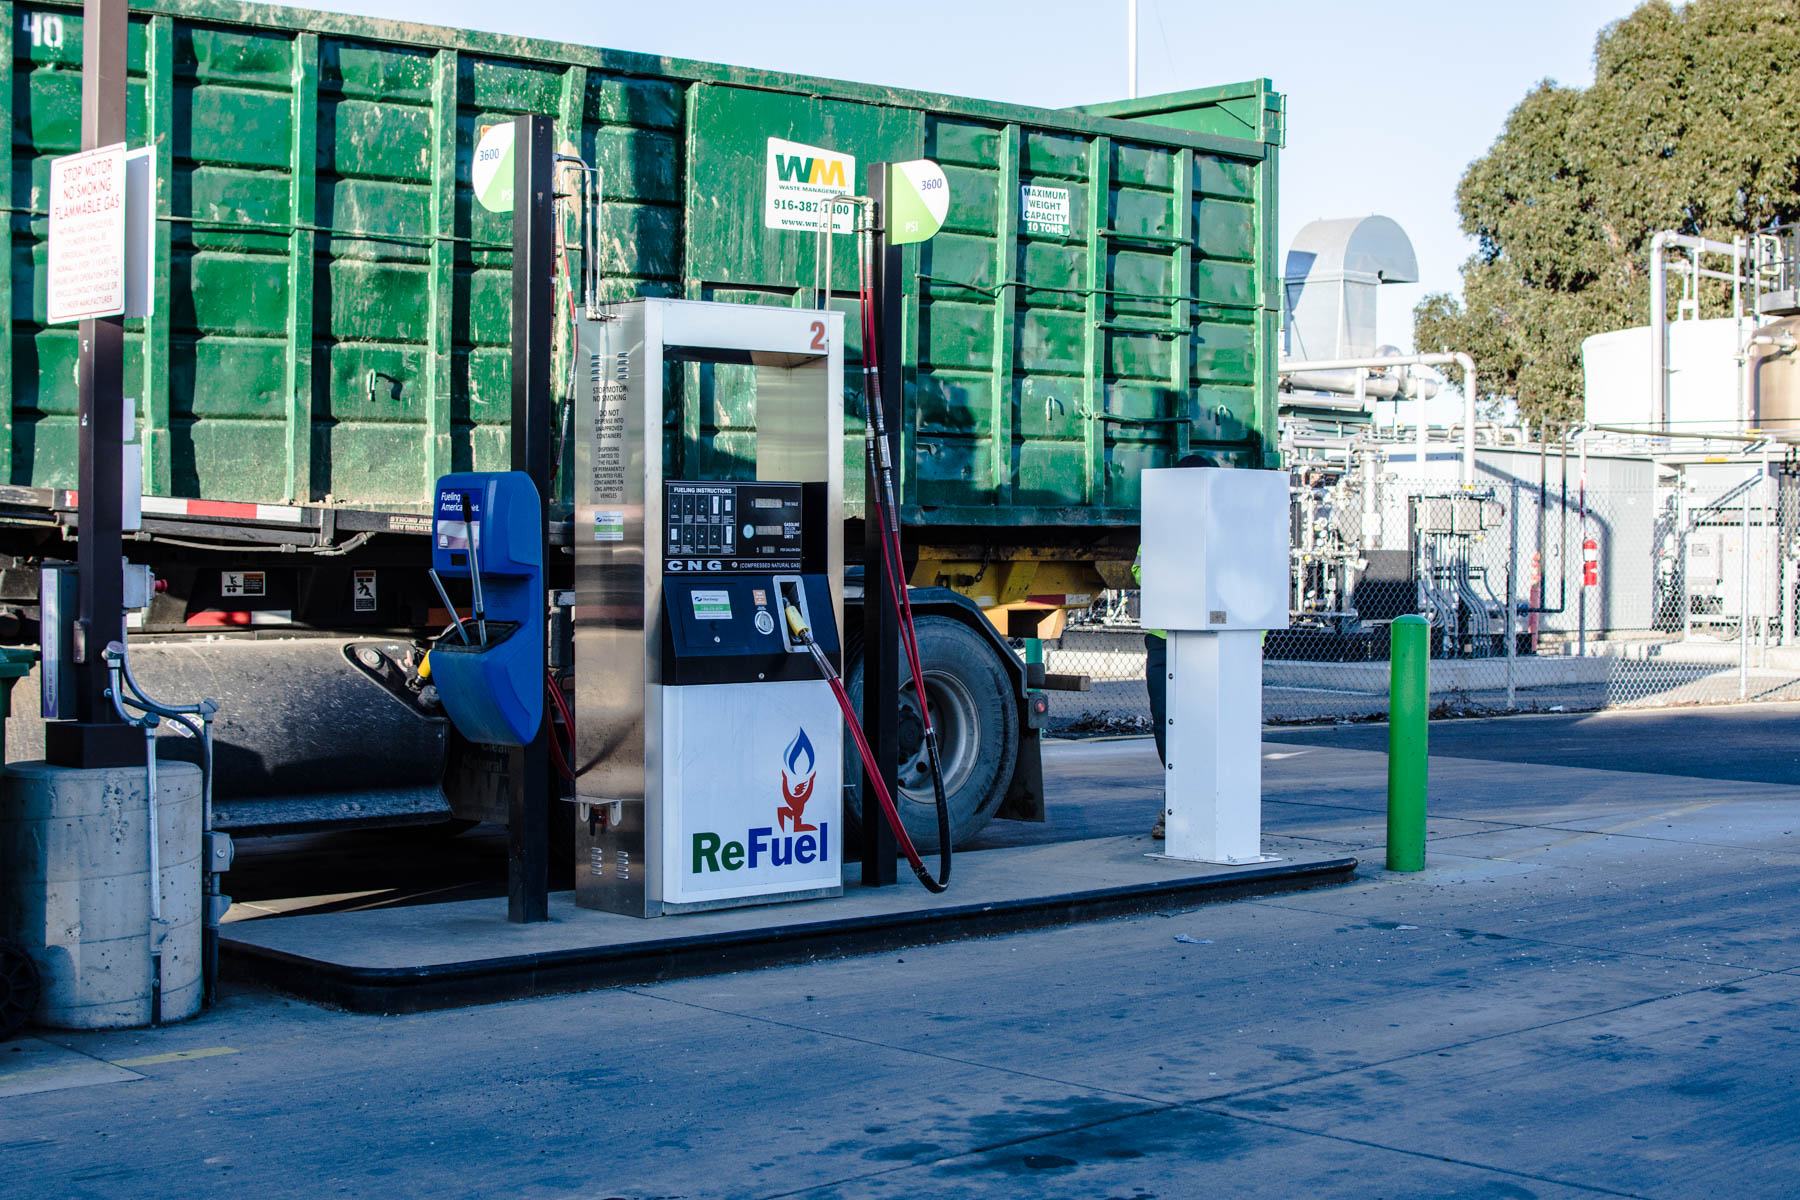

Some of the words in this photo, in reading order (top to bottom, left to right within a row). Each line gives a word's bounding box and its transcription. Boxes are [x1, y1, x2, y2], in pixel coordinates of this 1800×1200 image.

[23, 12, 64, 47] 40
[480, 148, 500, 161] 3600
[64, 166, 82, 183] STOP
[85, 158, 113, 176] MOTOR
[775, 154, 846, 187] WM
[64, 185, 75, 201] NO
[77, 177, 112, 198] SMOKING
[921, 178, 943, 191] 3600
[802, 187, 847, 196] MANAGEMENT
[1023, 188, 1067, 200] MAXIMUM
[55, 198, 102, 220] FLAMMABLE
[104, 193, 120, 210] GAS
[1029, 199, 1061, 210] WEIGHT
[1024, 210, 1067, 222] CAPACITY
[781, 219, 841, 229] www.wm.cm
[905, 220, 919, 232] PSI
[1028, 222, 1039, 232] 10
[1040, 223, 1064, 233] TONS
[810, 321, 825, 349] 2
[441, 492, 460, 503] Fueling
[667, 560, 722, 571] CNG
[692, 822, 828, 874] ReFuel
